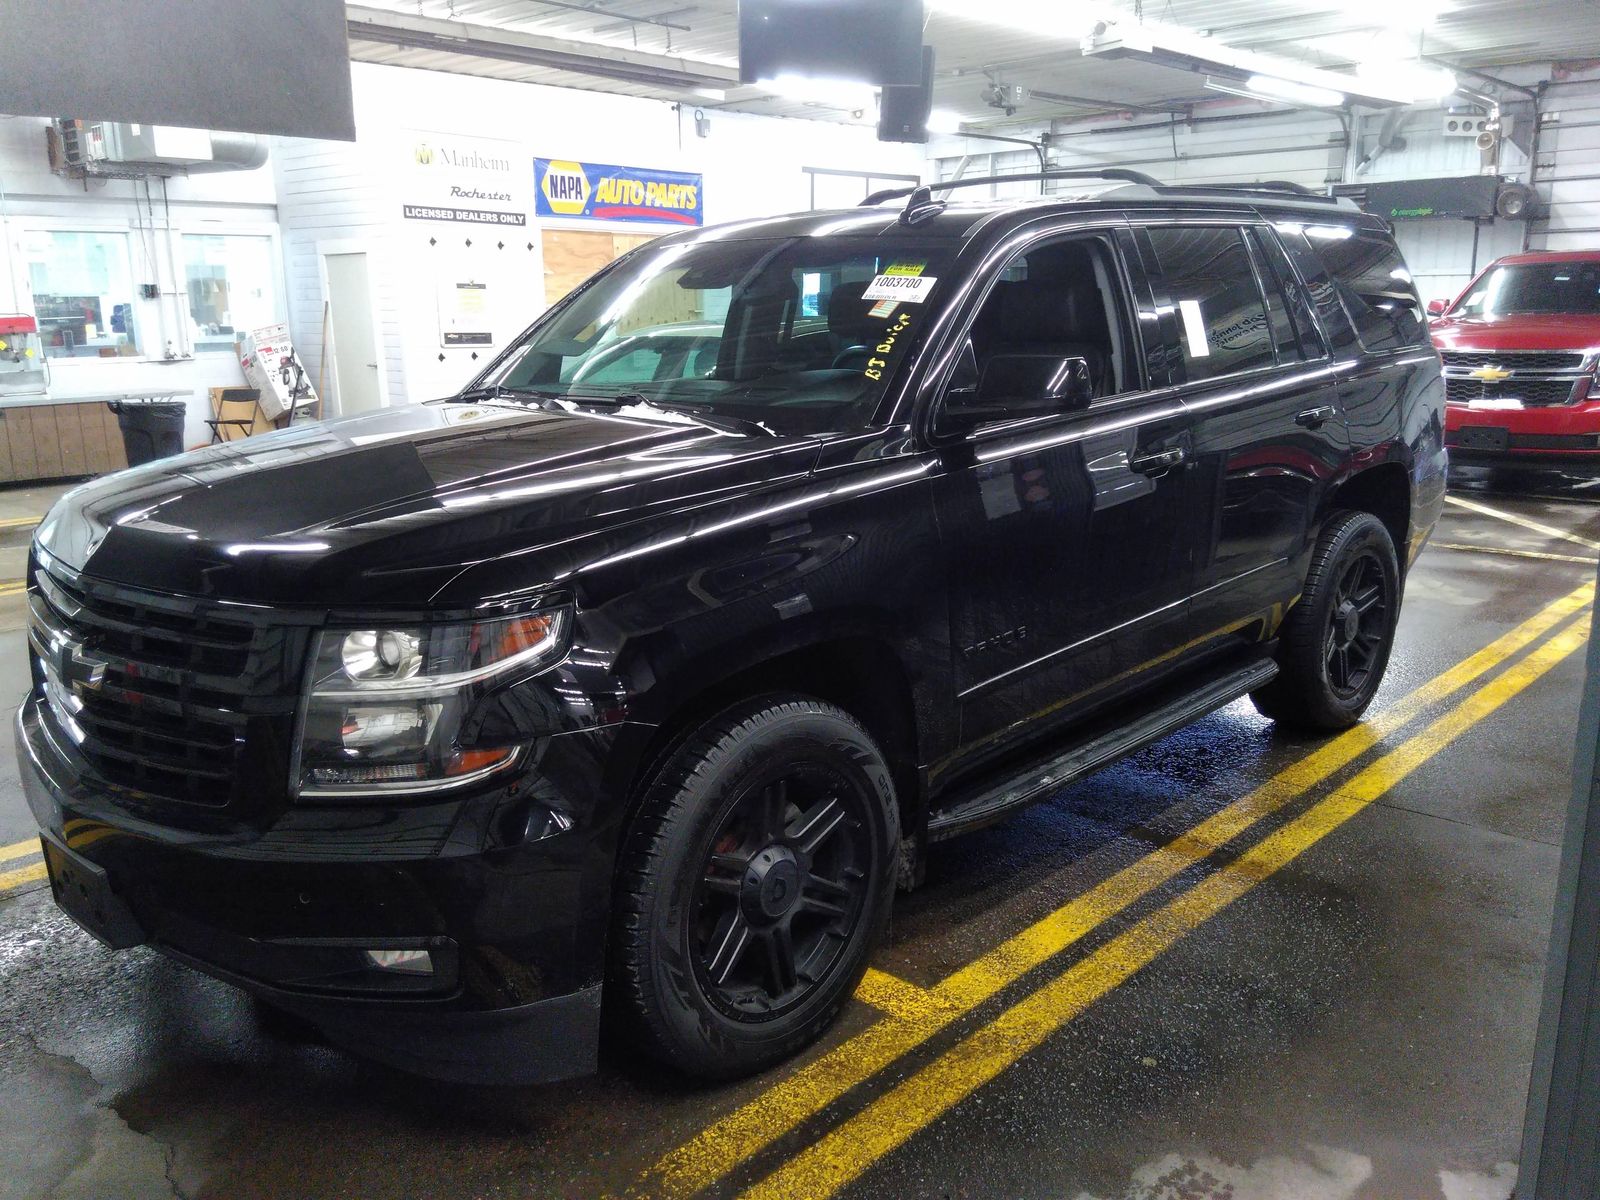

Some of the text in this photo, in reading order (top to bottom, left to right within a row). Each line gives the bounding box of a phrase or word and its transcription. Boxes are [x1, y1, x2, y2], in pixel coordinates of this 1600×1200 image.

[440, 148, 510, 172] Manheim
[450, 186, 512, 201] Rochester
[550, 174, 583, 200] NAPA
[595, 177, 697, 209] AUTO PARTS
[405, 207, 524, 224] LICENSED DEALERS ONLY
[875, 277, 923, 289] 1003700
